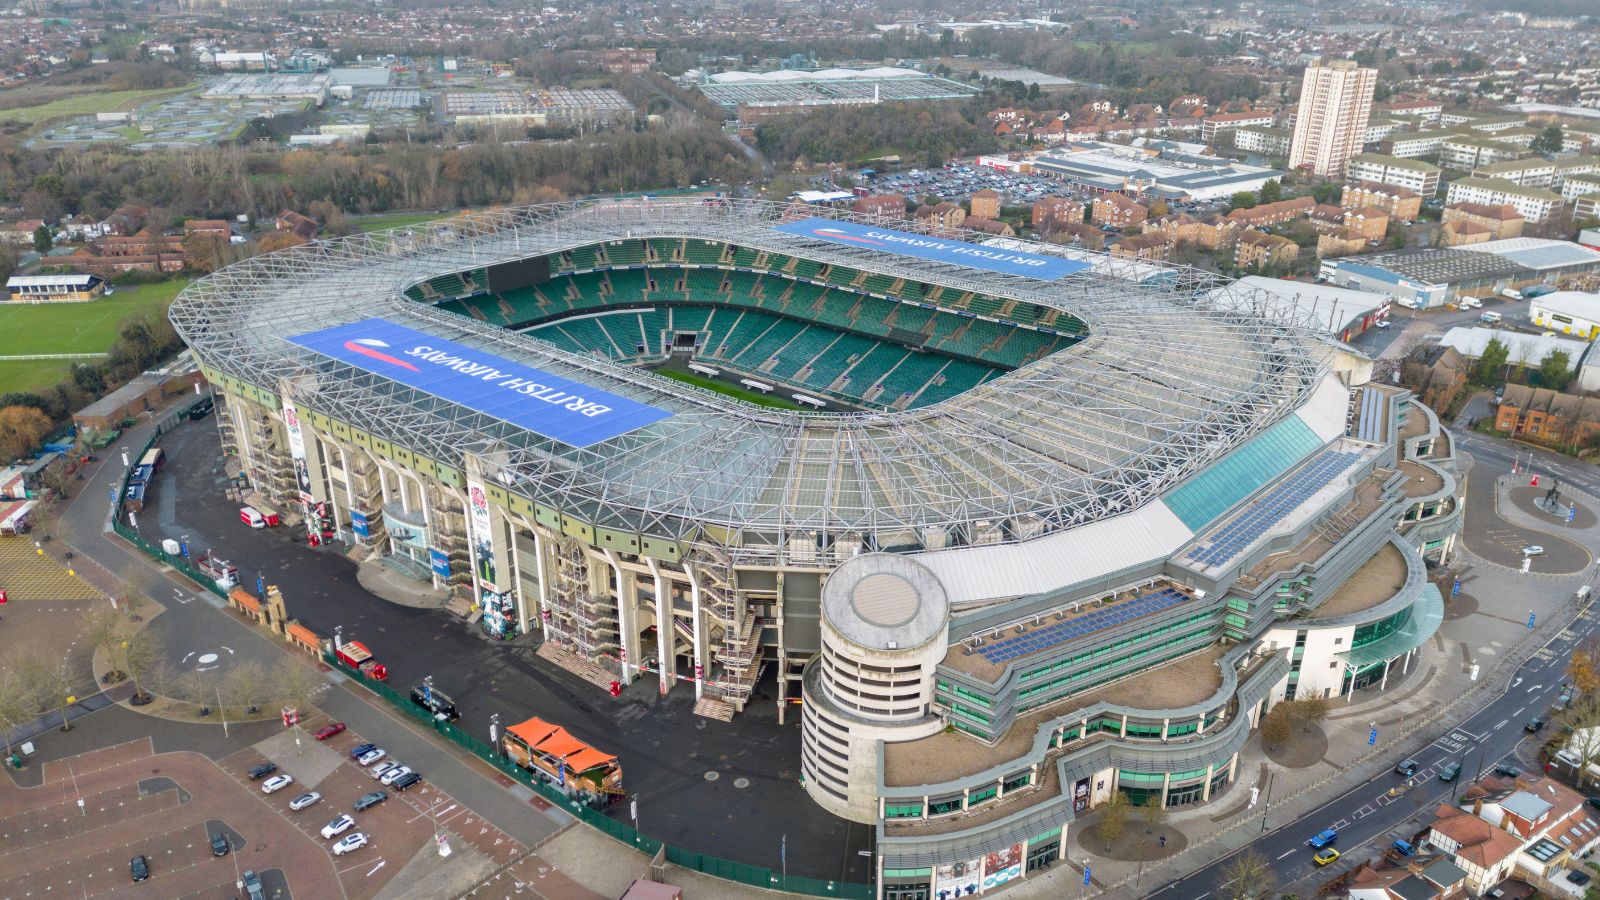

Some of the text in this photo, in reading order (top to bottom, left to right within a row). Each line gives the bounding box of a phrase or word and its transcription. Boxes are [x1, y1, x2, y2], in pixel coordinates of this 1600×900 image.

[862, 231, 1046, 265] BRITISH AIRWAYS
[404, 346, 612, 417] BRITISH AIRWAYS
[1440, 737, 1463, 749] CLEAR
[1450, 733, 1468, 742] KEEP
